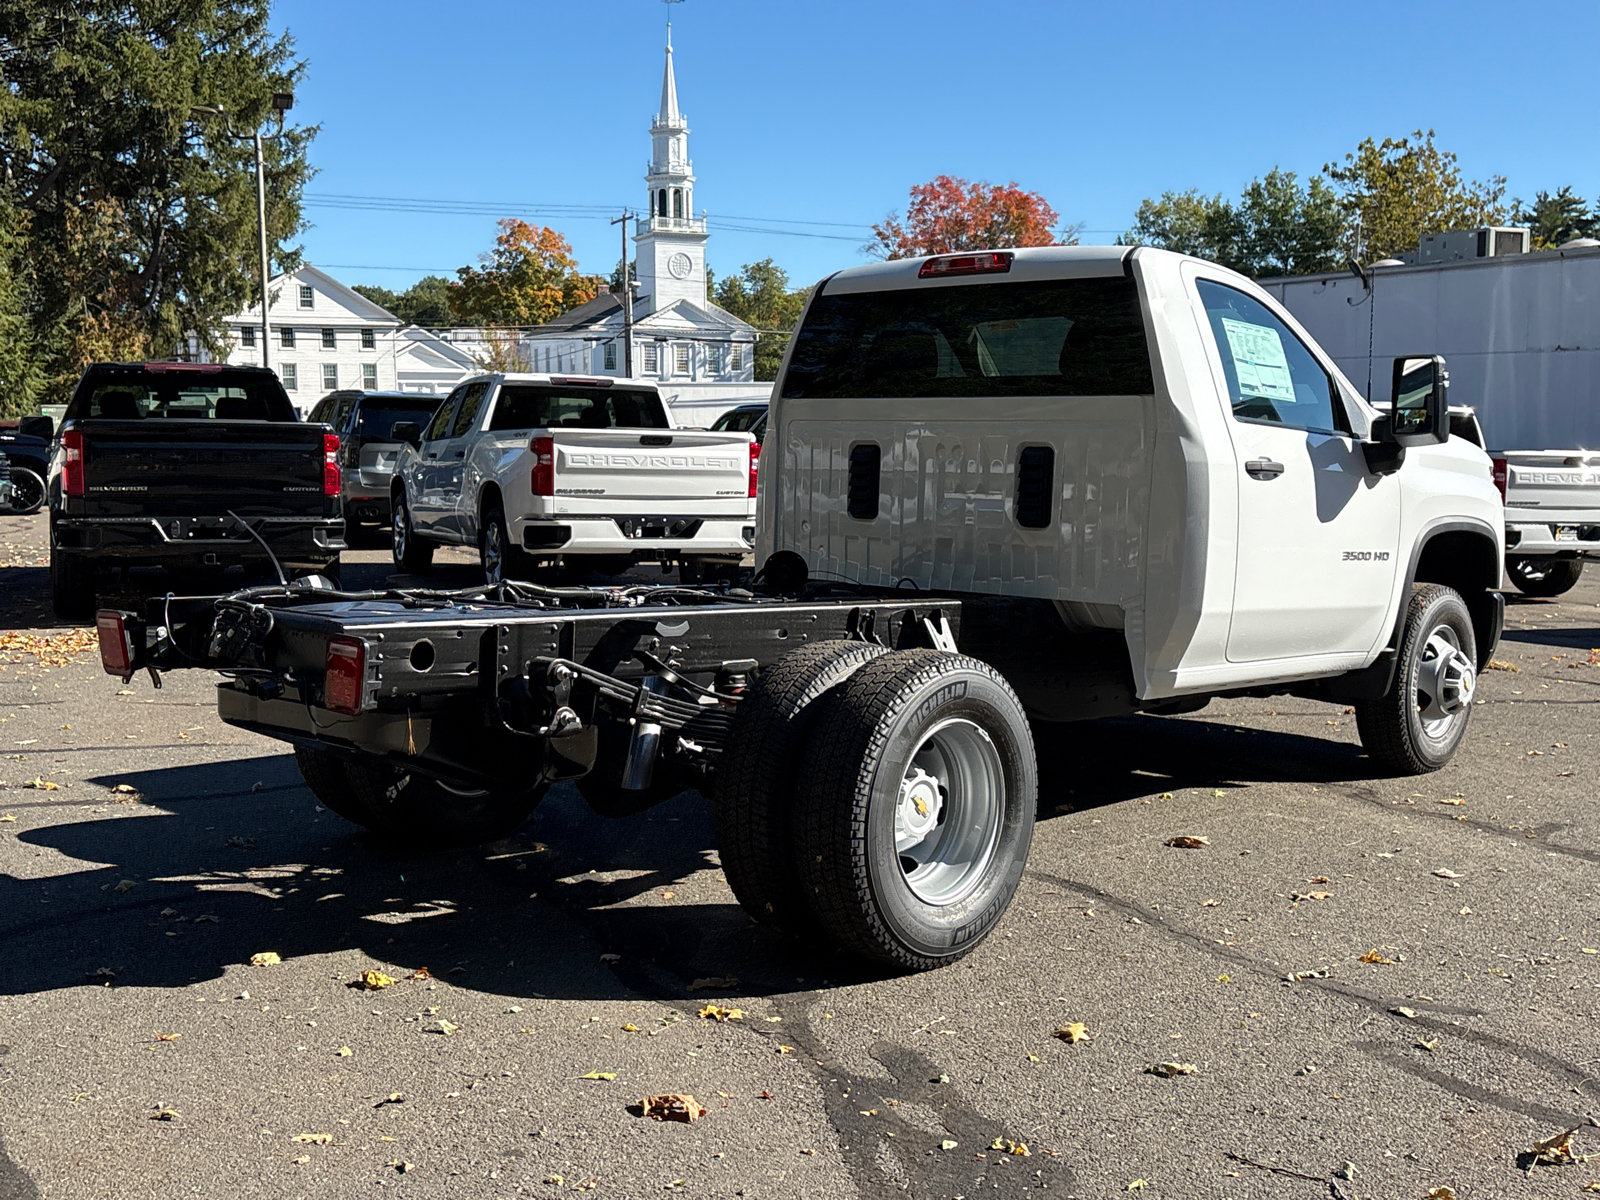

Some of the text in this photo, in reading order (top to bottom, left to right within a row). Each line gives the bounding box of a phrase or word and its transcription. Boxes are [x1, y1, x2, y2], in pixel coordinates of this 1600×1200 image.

[568, 454, 738, 468] CHEVROLET
[1342, 551, 1390, 561] 3500 HD
[907, 682, 966, 735] MICHELIN
[953, 883, 1010, 945] MICHELIN
